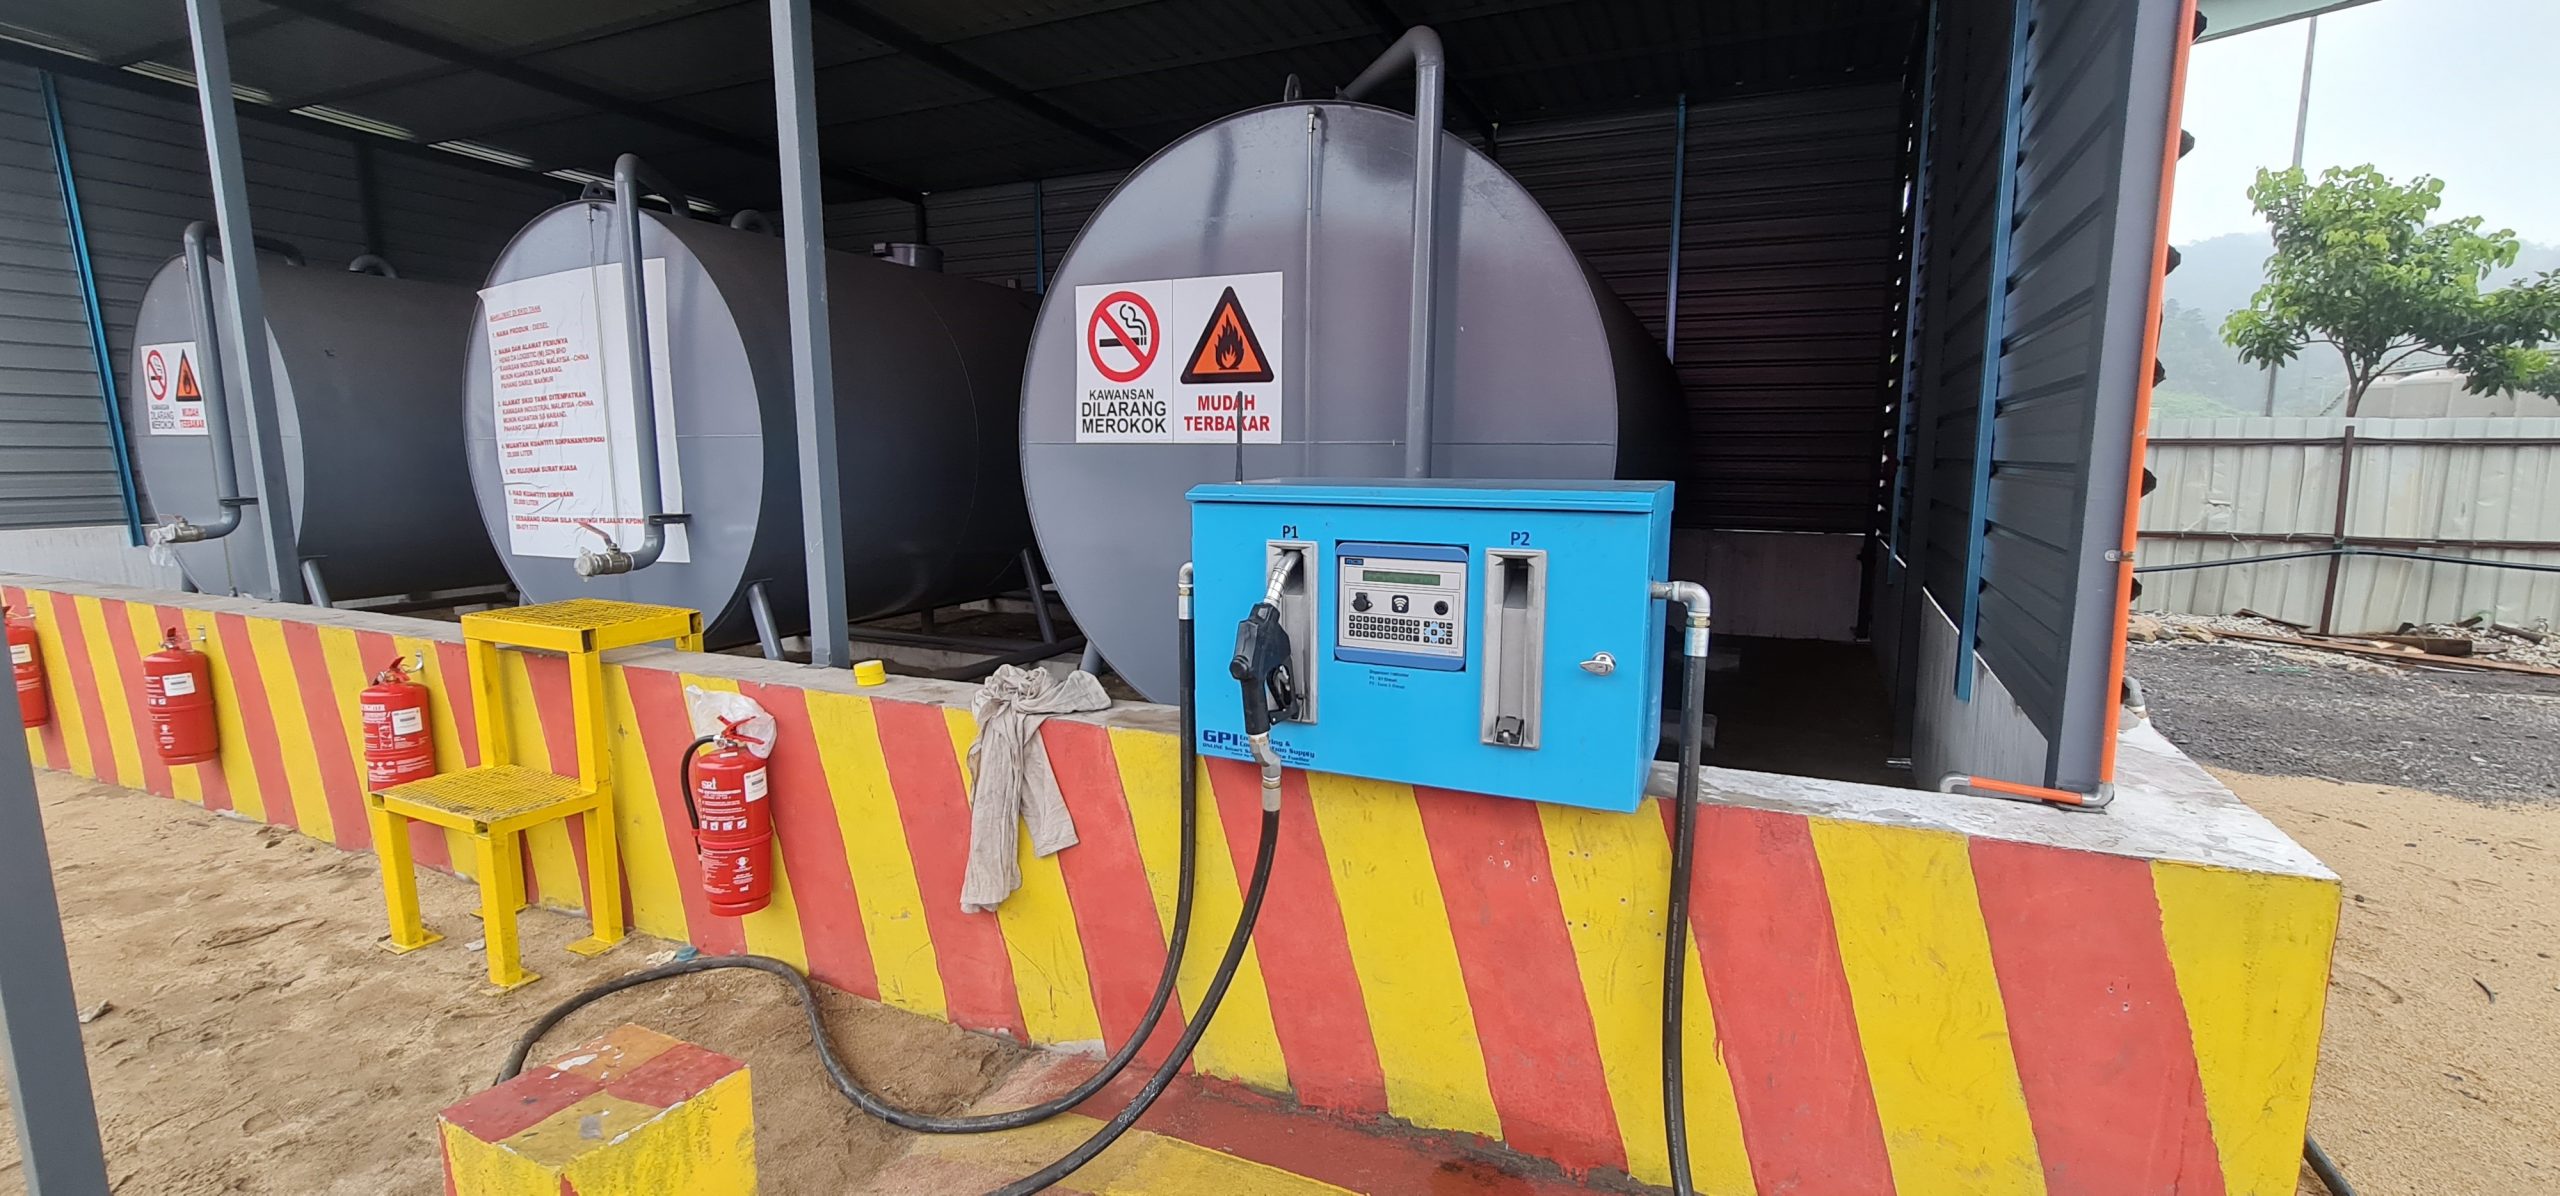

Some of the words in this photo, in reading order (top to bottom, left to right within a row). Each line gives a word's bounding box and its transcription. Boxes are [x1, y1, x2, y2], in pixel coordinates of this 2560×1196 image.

[1089, 389, 1154, 400] KAWANSAN
[1082, 401, 1166, 417] DILARANG
[1082, 418, 1167, 433] MEROKOK
[1282, 525, 1299, 539] P1
[1511, 532, 1530, 546] P2
[1203, 729, 1238, 746] GPI
[1289, 748, 1315, 758] Supply
